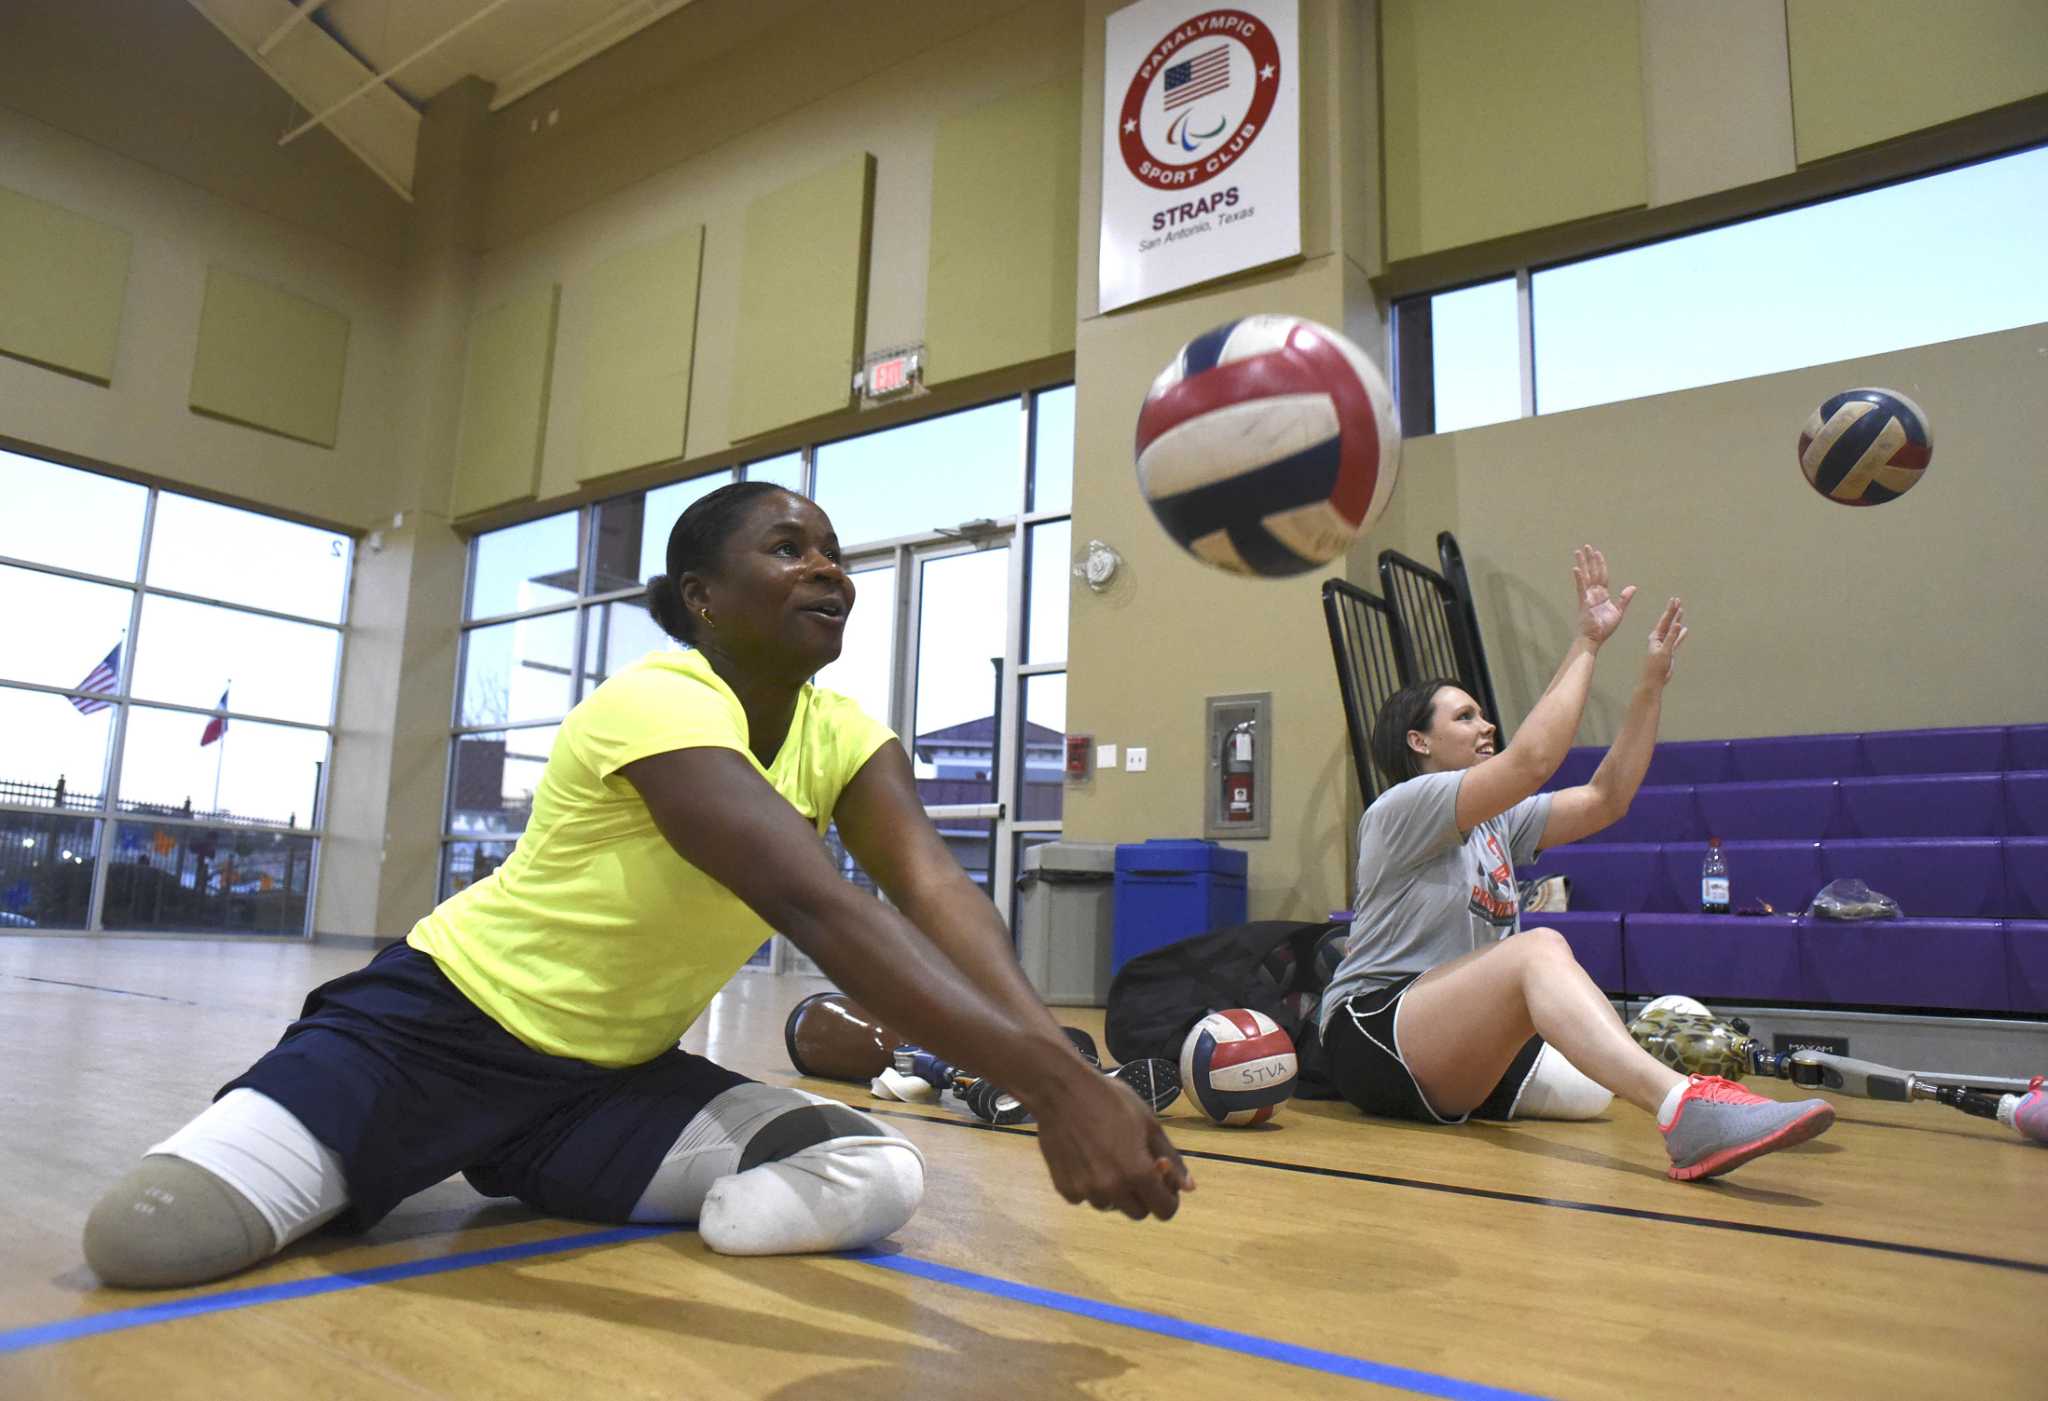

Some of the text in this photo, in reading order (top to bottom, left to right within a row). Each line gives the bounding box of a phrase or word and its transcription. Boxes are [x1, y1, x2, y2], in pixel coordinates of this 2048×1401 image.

[1141, 15, 1256, 80] PARALYMPIC
[1138, 122, 1256, 184] SPORT CLUB
[1138, 206, 1255, 253] San Antonio, Texas
[1152, 186, 1240, 231] STRAPS
[1242, 1062, 1287, 1084] STVA
